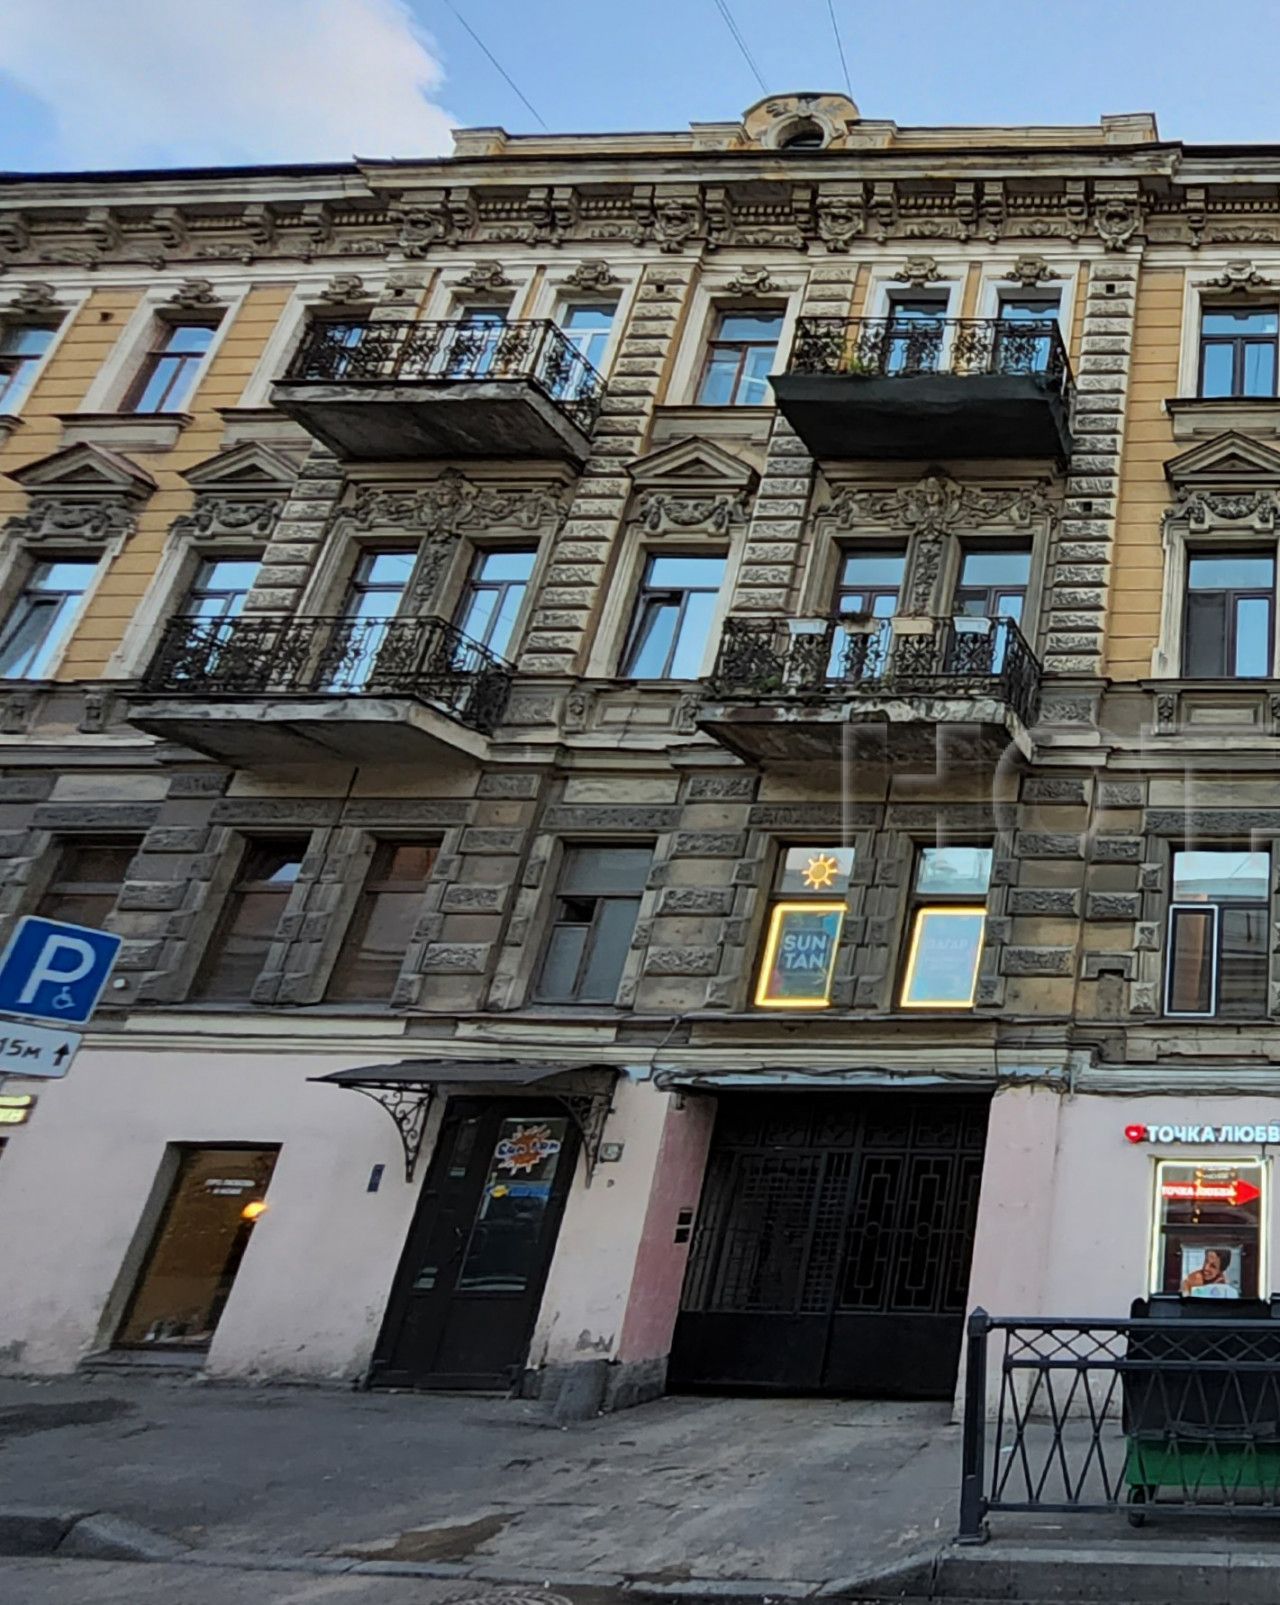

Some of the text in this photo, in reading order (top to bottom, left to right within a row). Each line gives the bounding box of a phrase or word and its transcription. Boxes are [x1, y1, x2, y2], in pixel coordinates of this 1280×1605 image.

[784, 935, 826, 950] SUN
[17, 934, 96, 1004] P
[784, 952, 825, 969] TAN
[1147, 1125, 1215, 1143] ТОЧКА
[1162, 1185, 1194, 1197] ТОЧКА
